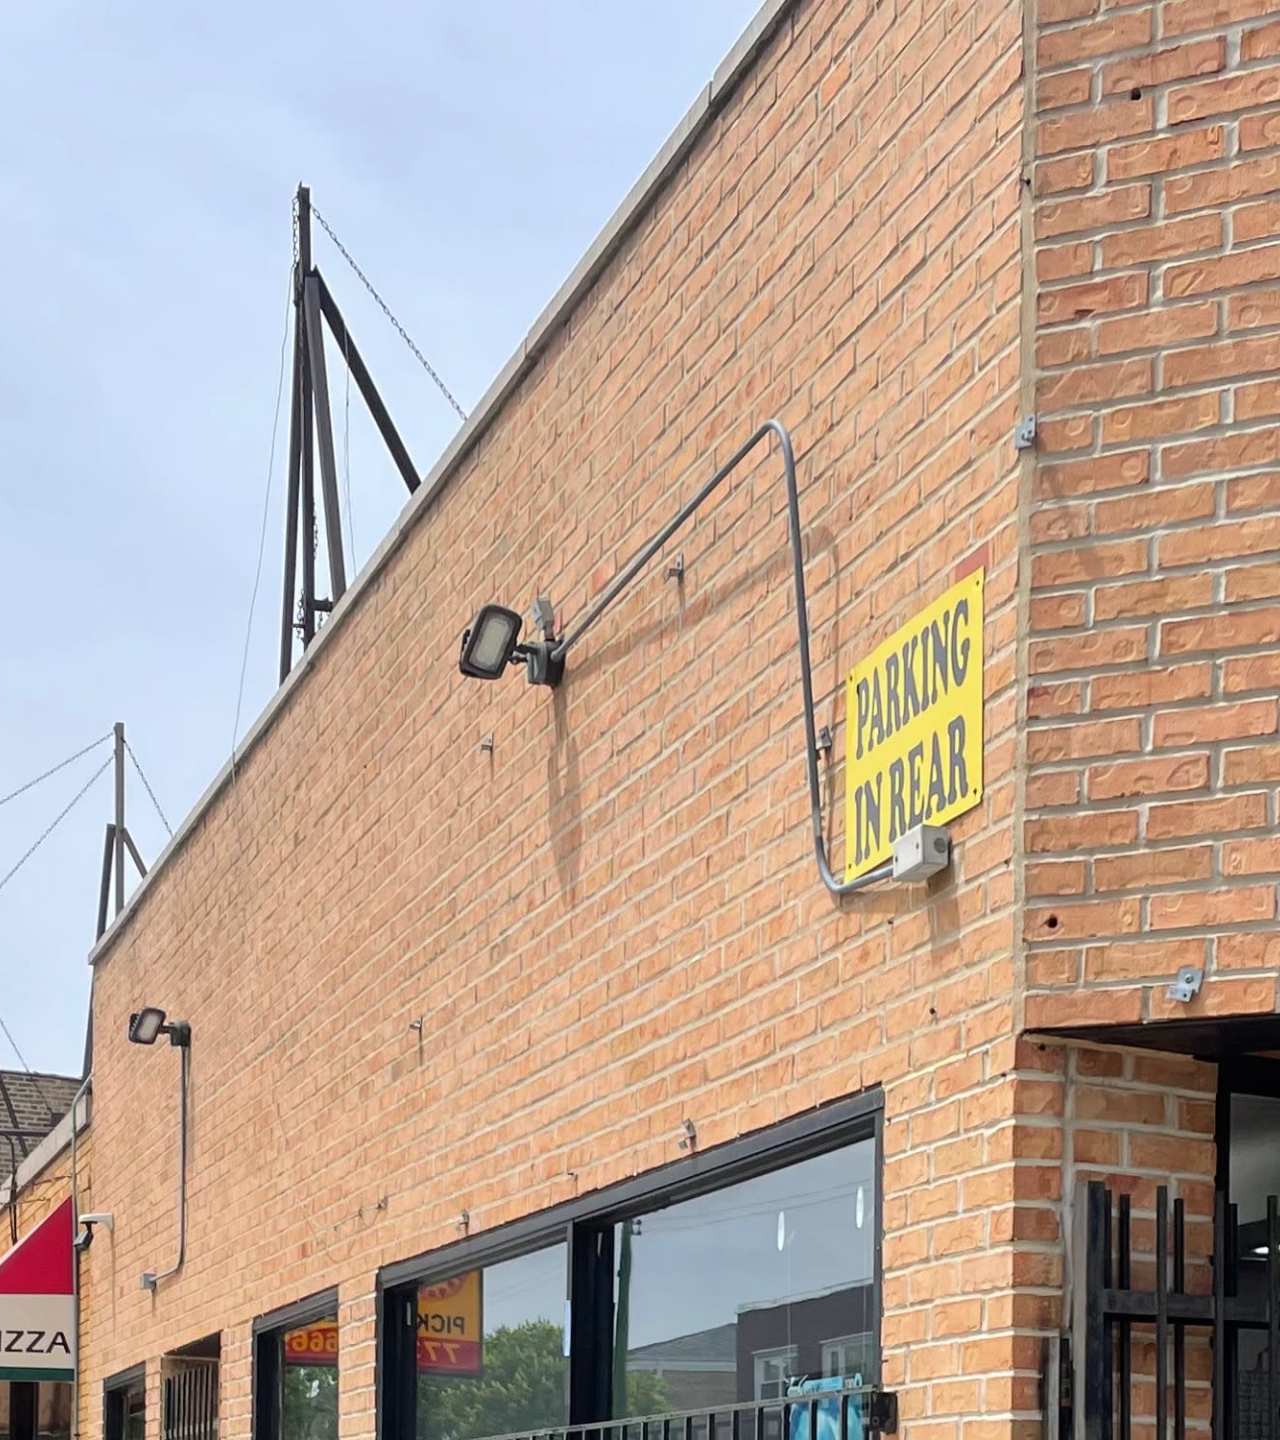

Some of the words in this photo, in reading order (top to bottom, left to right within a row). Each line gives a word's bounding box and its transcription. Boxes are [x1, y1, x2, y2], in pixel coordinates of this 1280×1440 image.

[856, 597, 970, 761] PARKING
[854, 770, 883, 867] IN
[888, 714, 969, 843] REAR
